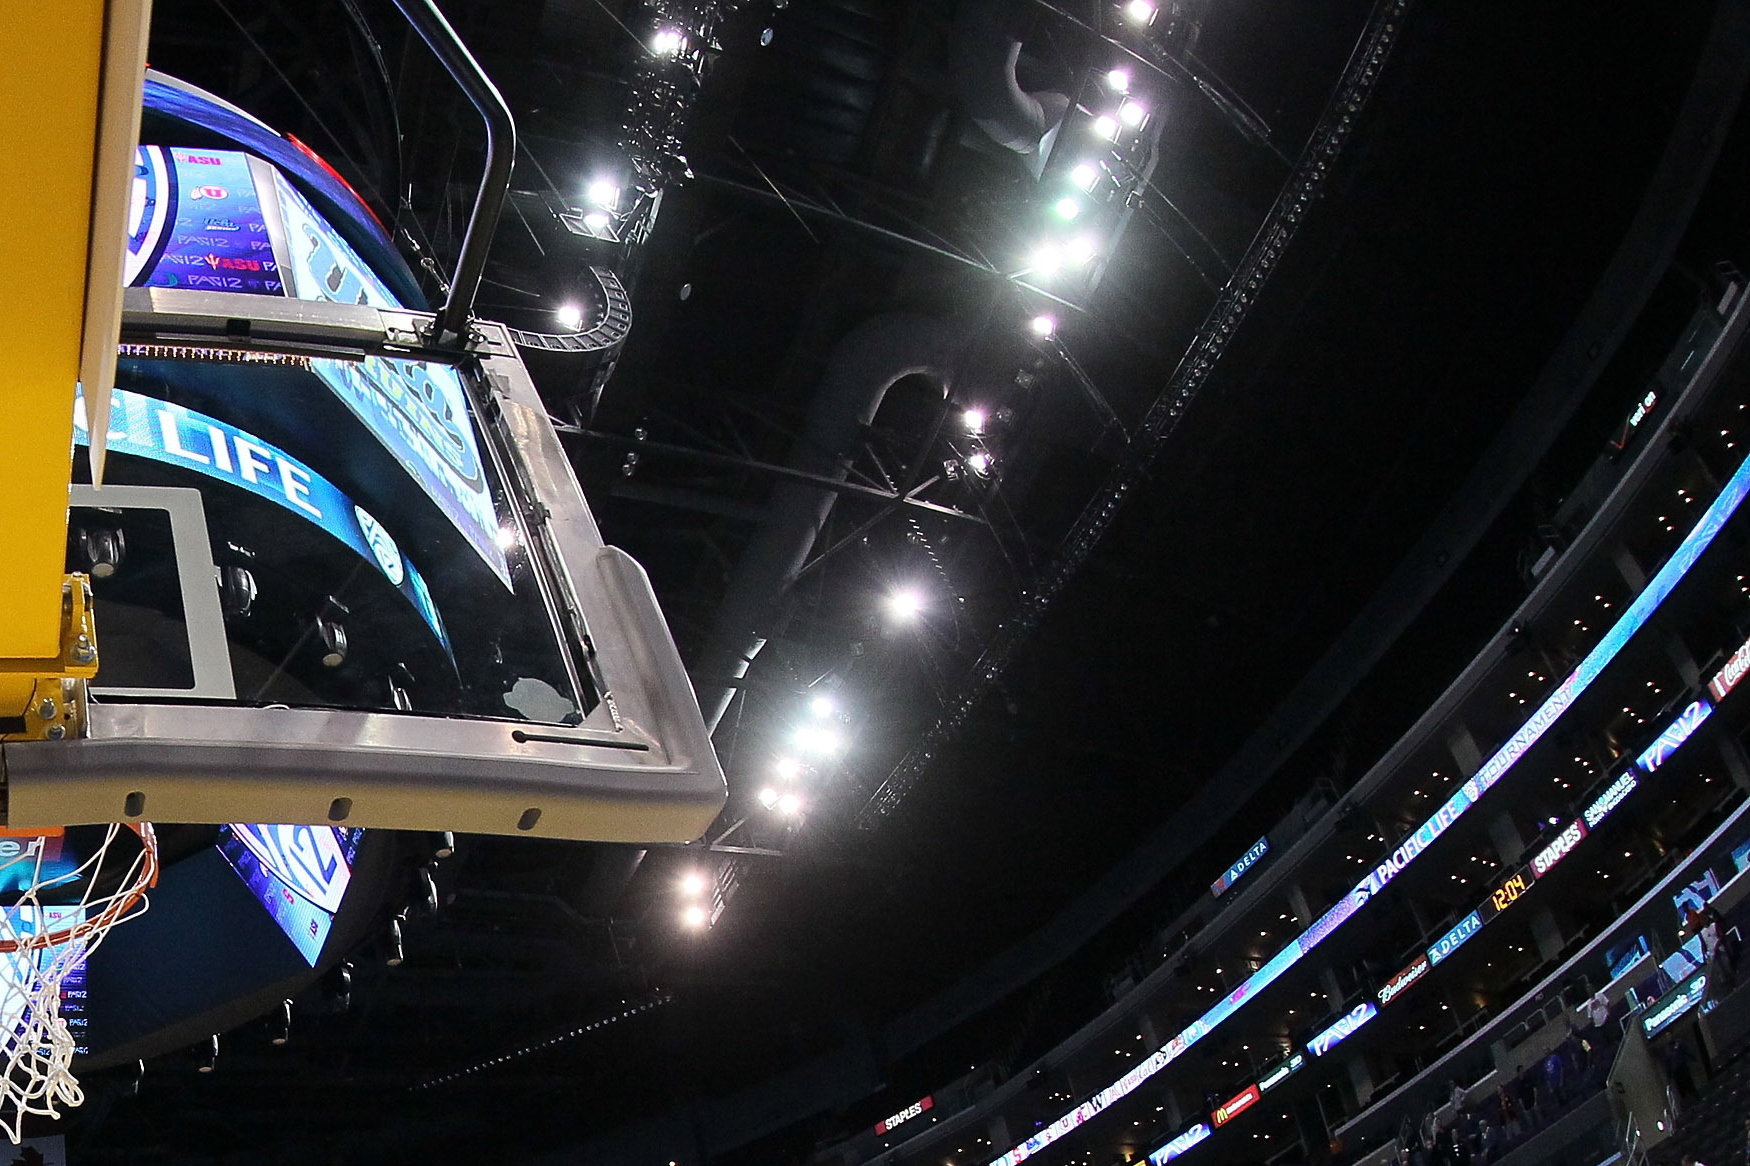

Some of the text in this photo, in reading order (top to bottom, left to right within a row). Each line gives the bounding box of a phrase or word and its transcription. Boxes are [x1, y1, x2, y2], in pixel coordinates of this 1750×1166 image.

[160, 408, 324, 520] LIFE
[1376, 687, 1577, 885] PACIFIC LIFE TOURNAMENT
[1236, 842, 1267, 872] DELTA
[1534, 823, 1582, 875] STAPLES
[1492, 875, 1525, 911] 12:04
[1440, 915, 1481, 954] DELTA
[1377, 960, 1428, 1005] Budweiser
[884, 1101, 923, 1131] STAPLES
